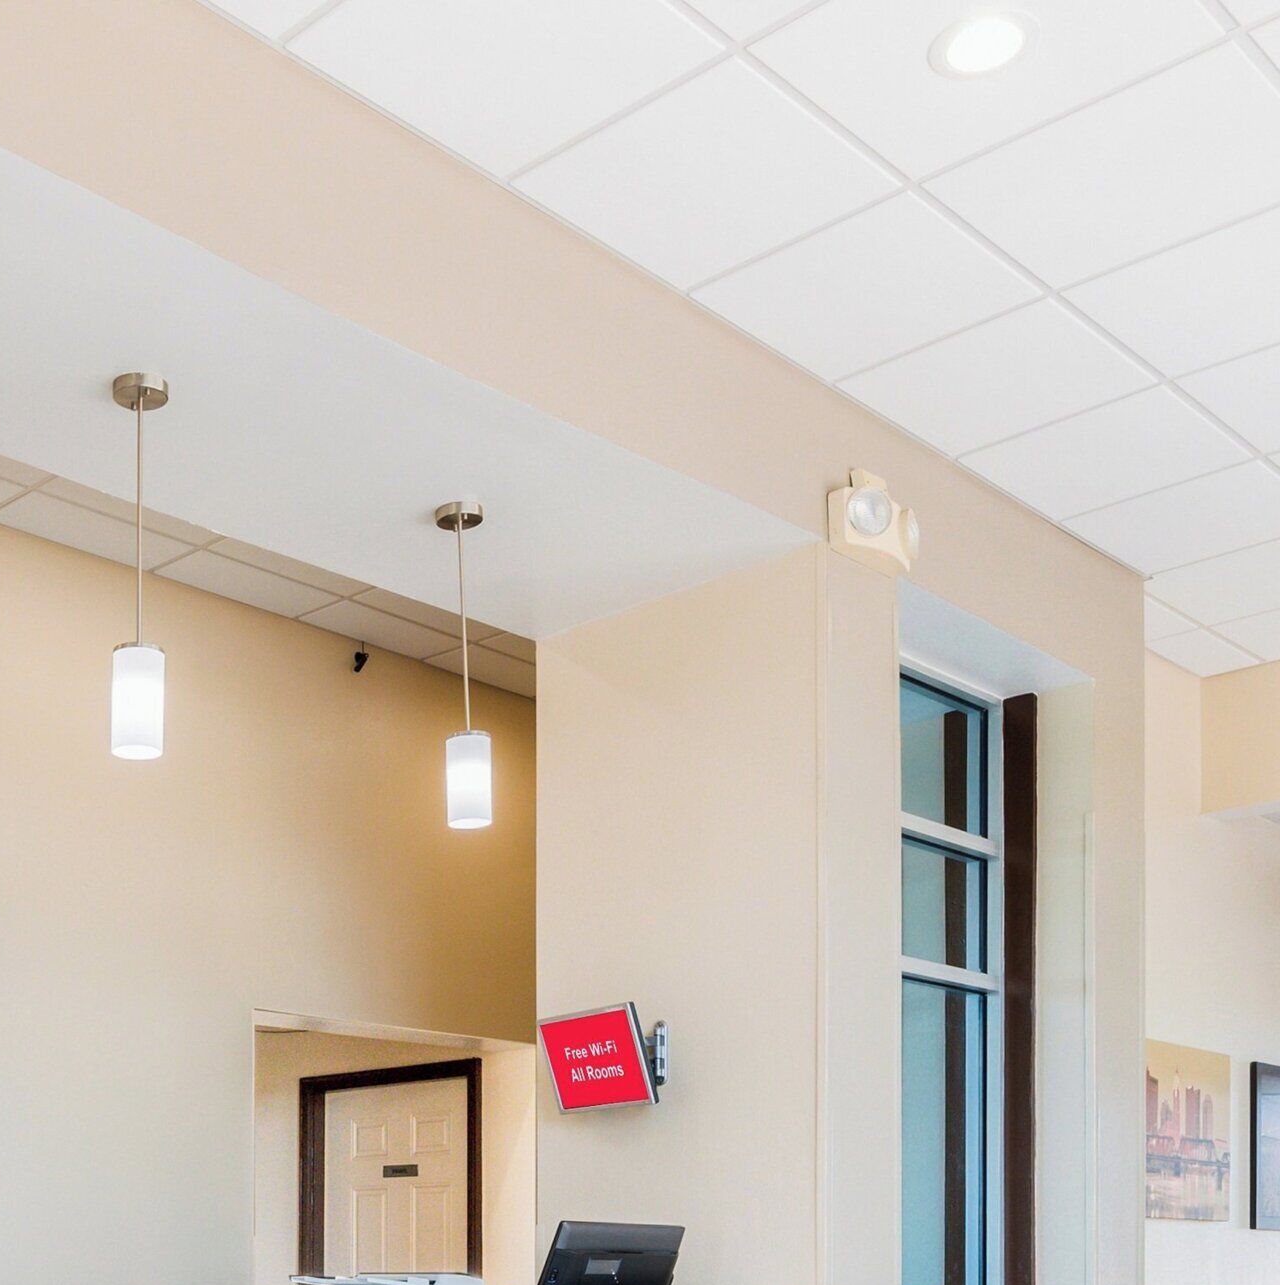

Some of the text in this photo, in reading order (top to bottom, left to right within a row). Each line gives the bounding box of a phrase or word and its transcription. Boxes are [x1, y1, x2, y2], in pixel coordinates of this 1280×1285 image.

[564, 1040, 617, 1060] Free Wi-Fi
[571, 1064, 624, 1082] All Rooms
